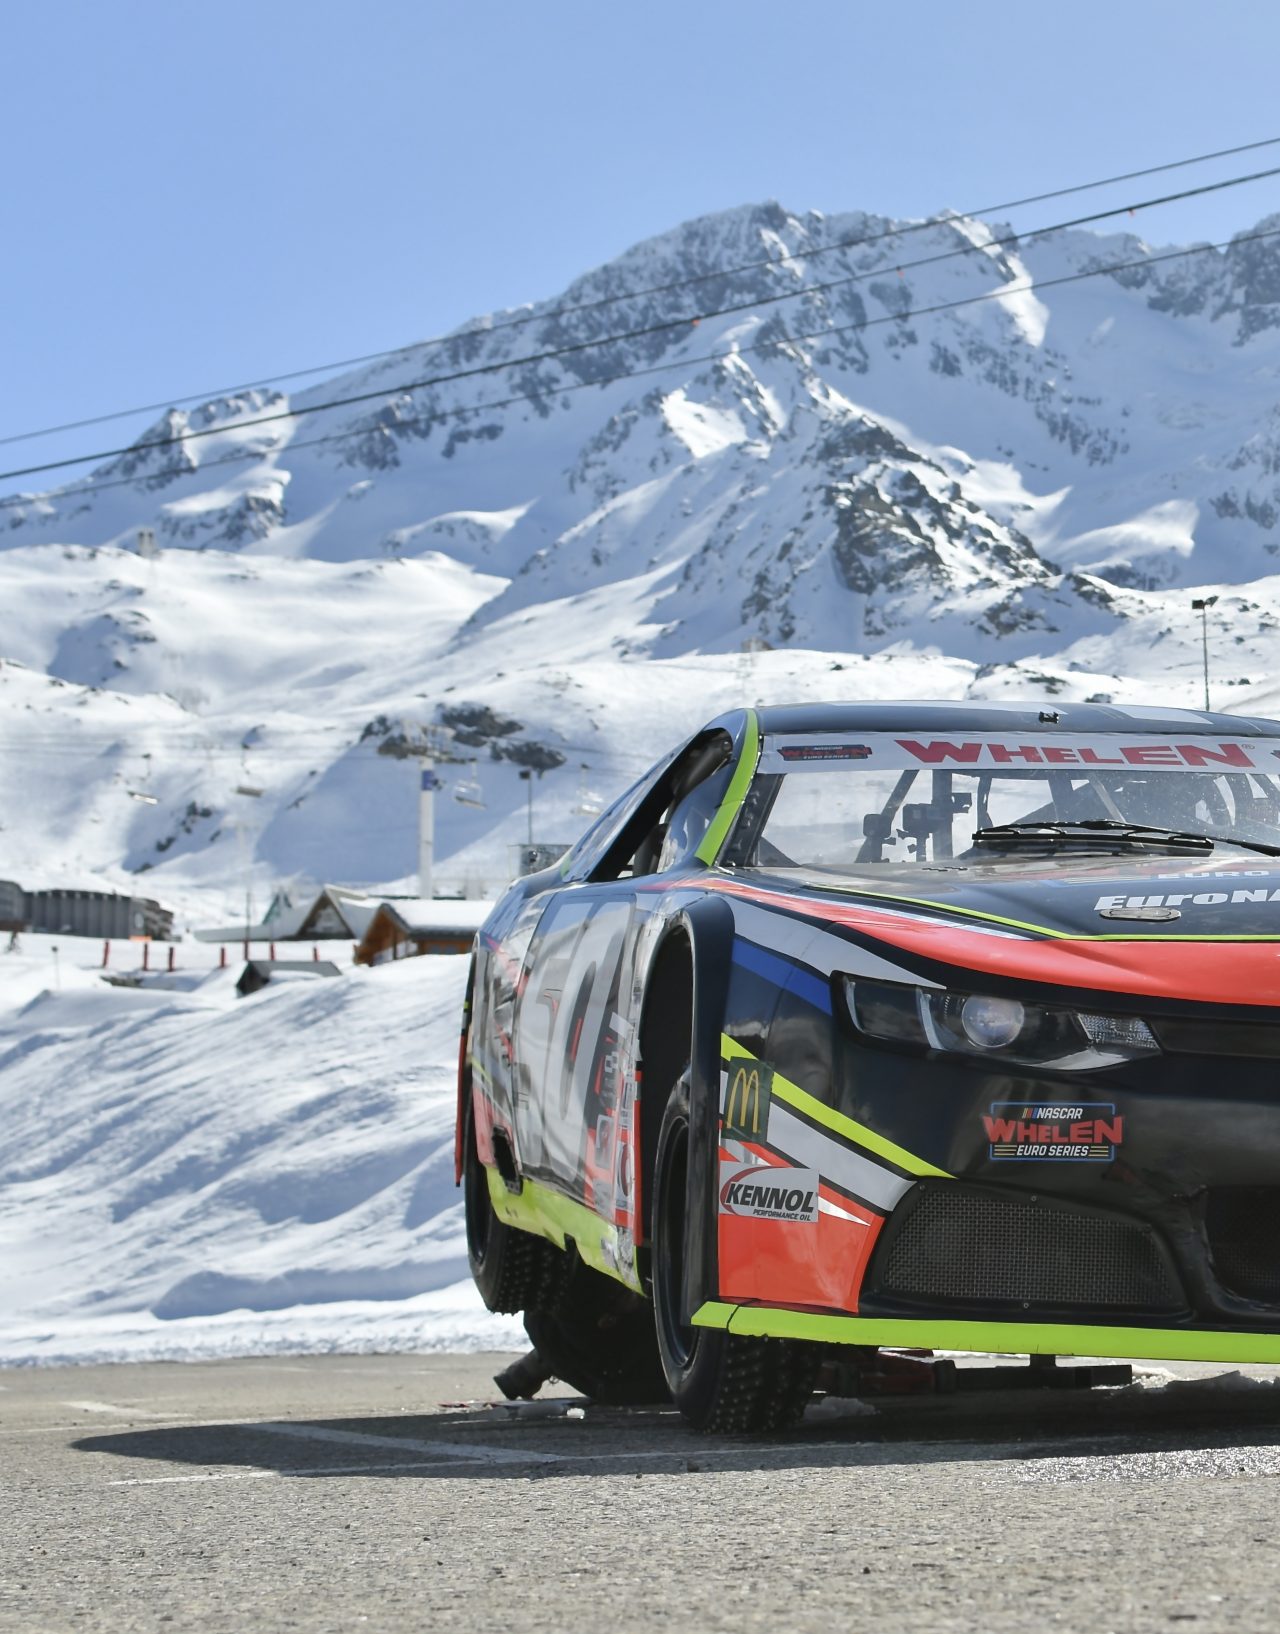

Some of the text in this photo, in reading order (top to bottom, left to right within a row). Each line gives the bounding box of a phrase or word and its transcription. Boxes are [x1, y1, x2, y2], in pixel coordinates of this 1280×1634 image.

[894, 740, 1256, 768] WHELEN
[1037, 1107, 1083, 1119] NASCAR
[983, 1116, 1123, 1144] WHELEN
[1016, 1145, 1089, 1156] EURO SERIES
[726, 1183, 814, 1213] KENNOL
[753, 1209, 799, 1220] PERFORMANCE
